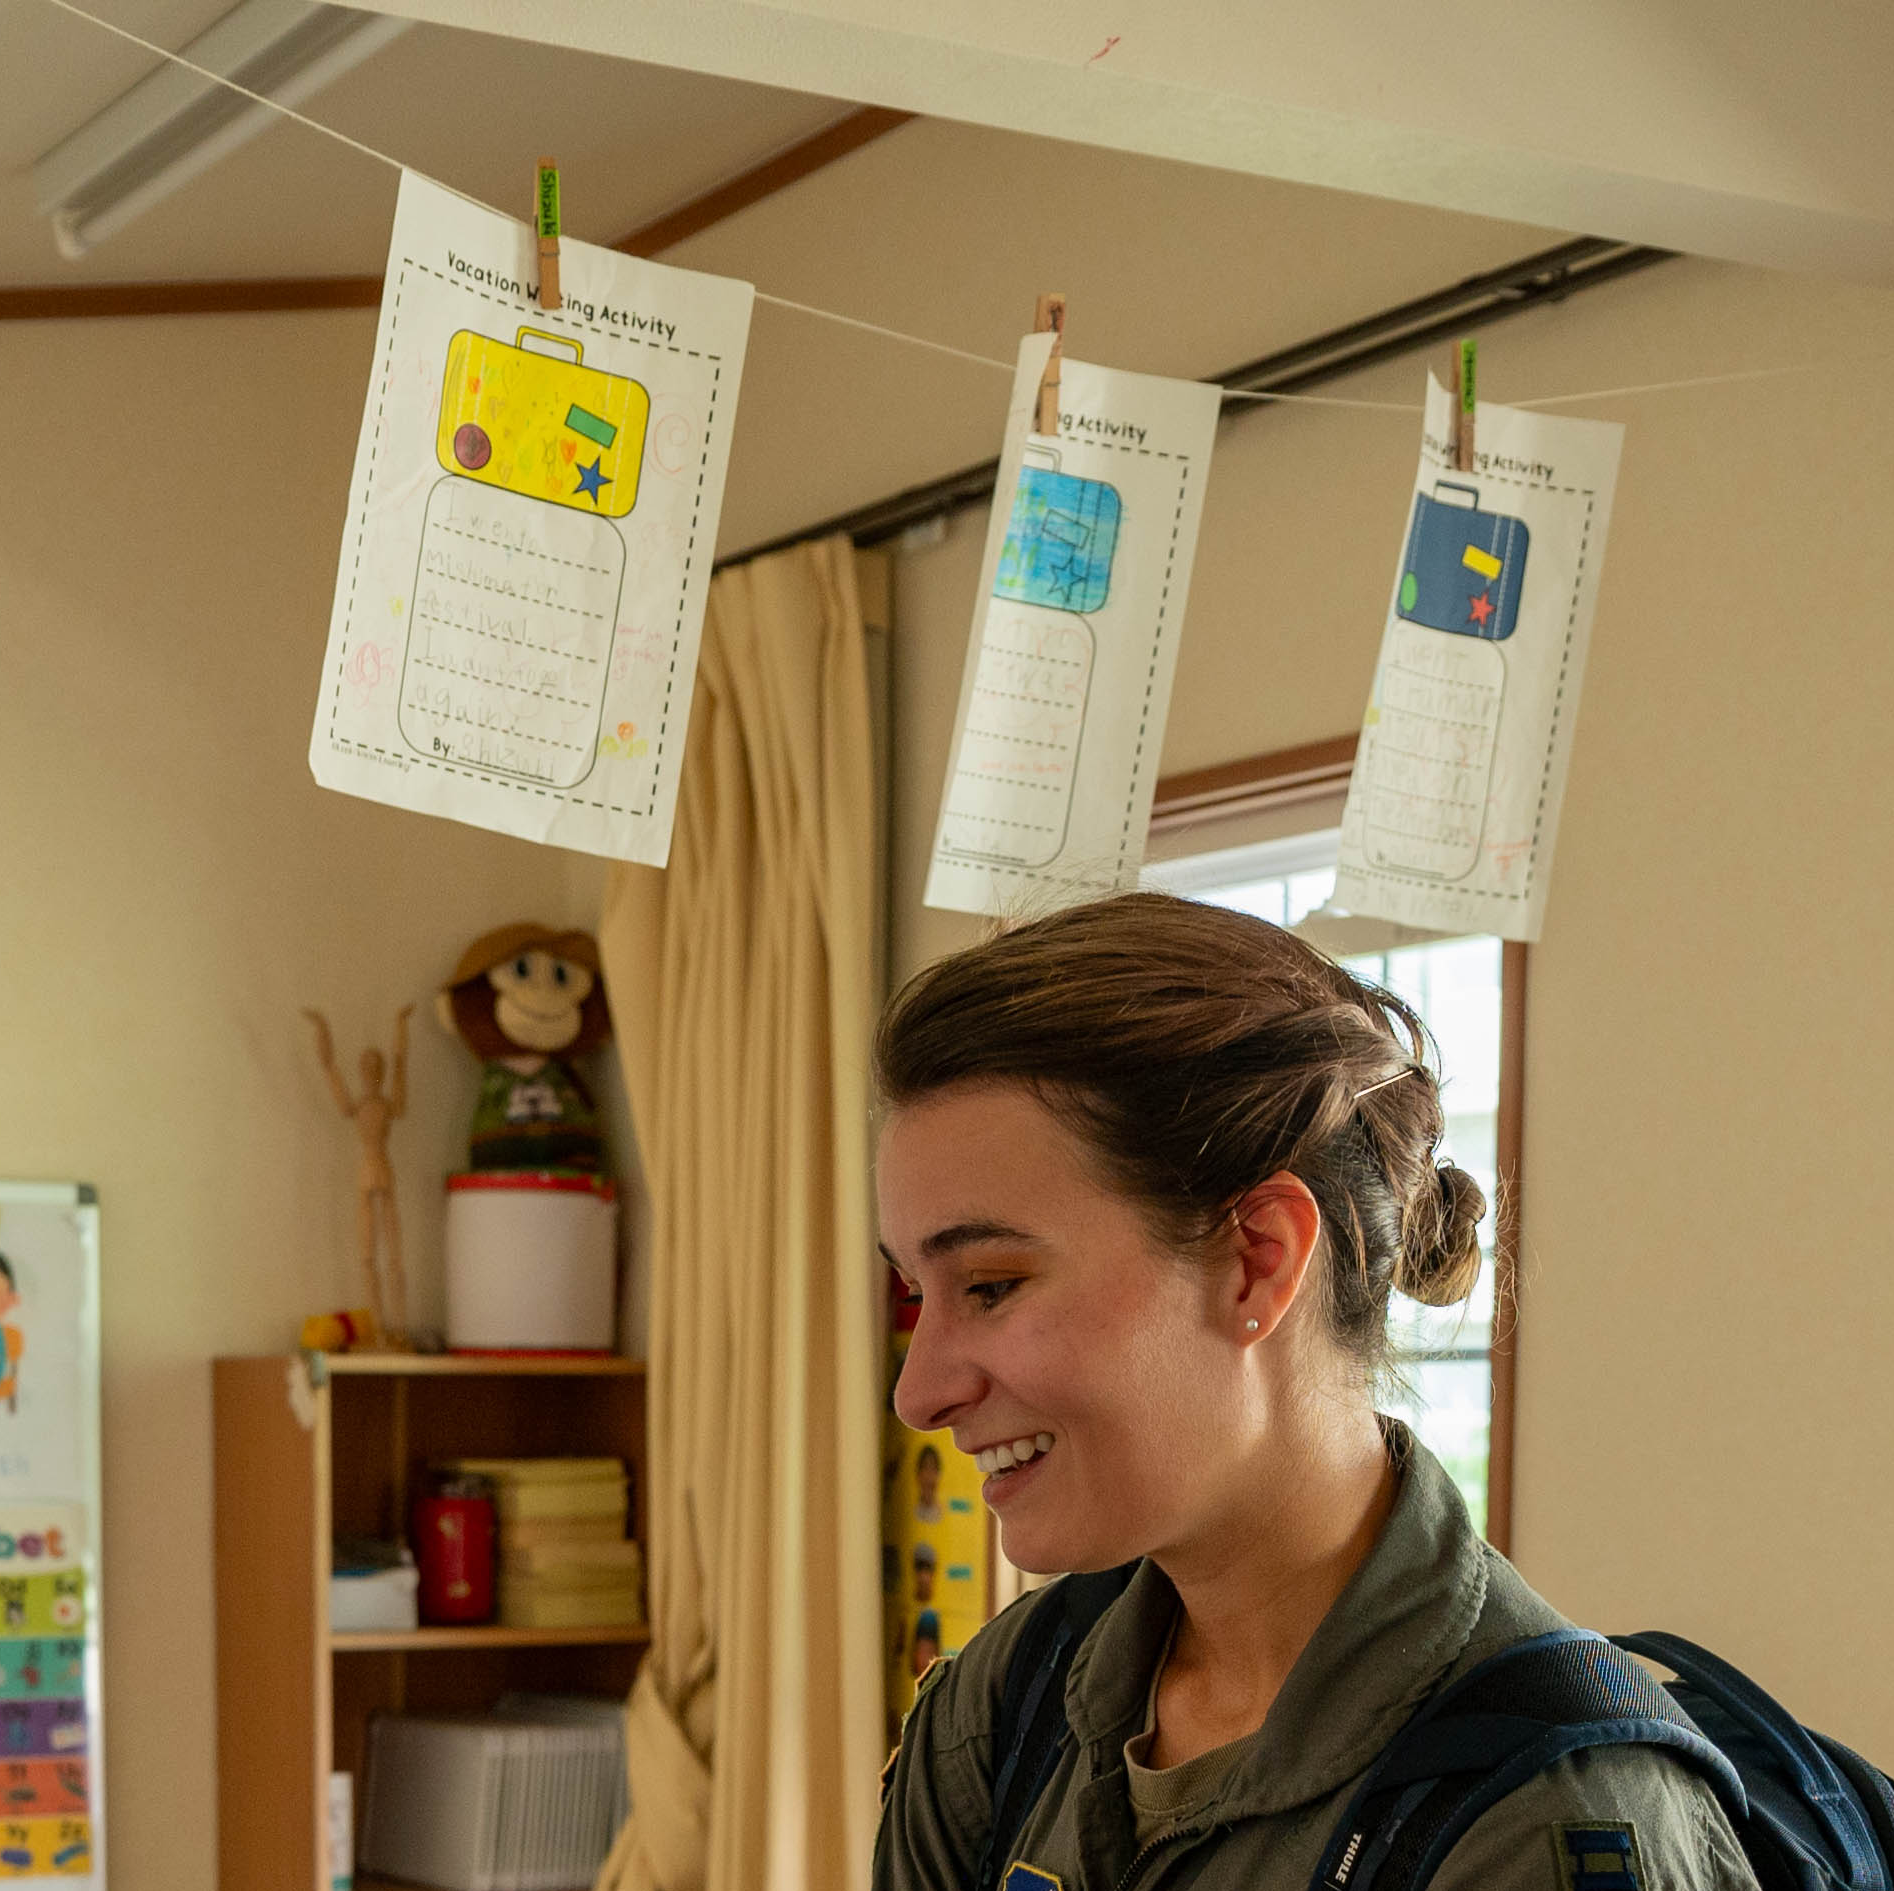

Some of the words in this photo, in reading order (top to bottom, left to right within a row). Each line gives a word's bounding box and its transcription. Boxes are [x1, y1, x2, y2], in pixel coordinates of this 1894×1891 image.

[448, 250, 521, 296] Vacation
[526, 281, 594, 322] Wing
[600, 304, 677, 342] Activity
[1076, 414, 1147, 446] Activity
[1335, 1833, 1362, 1883] THULE
